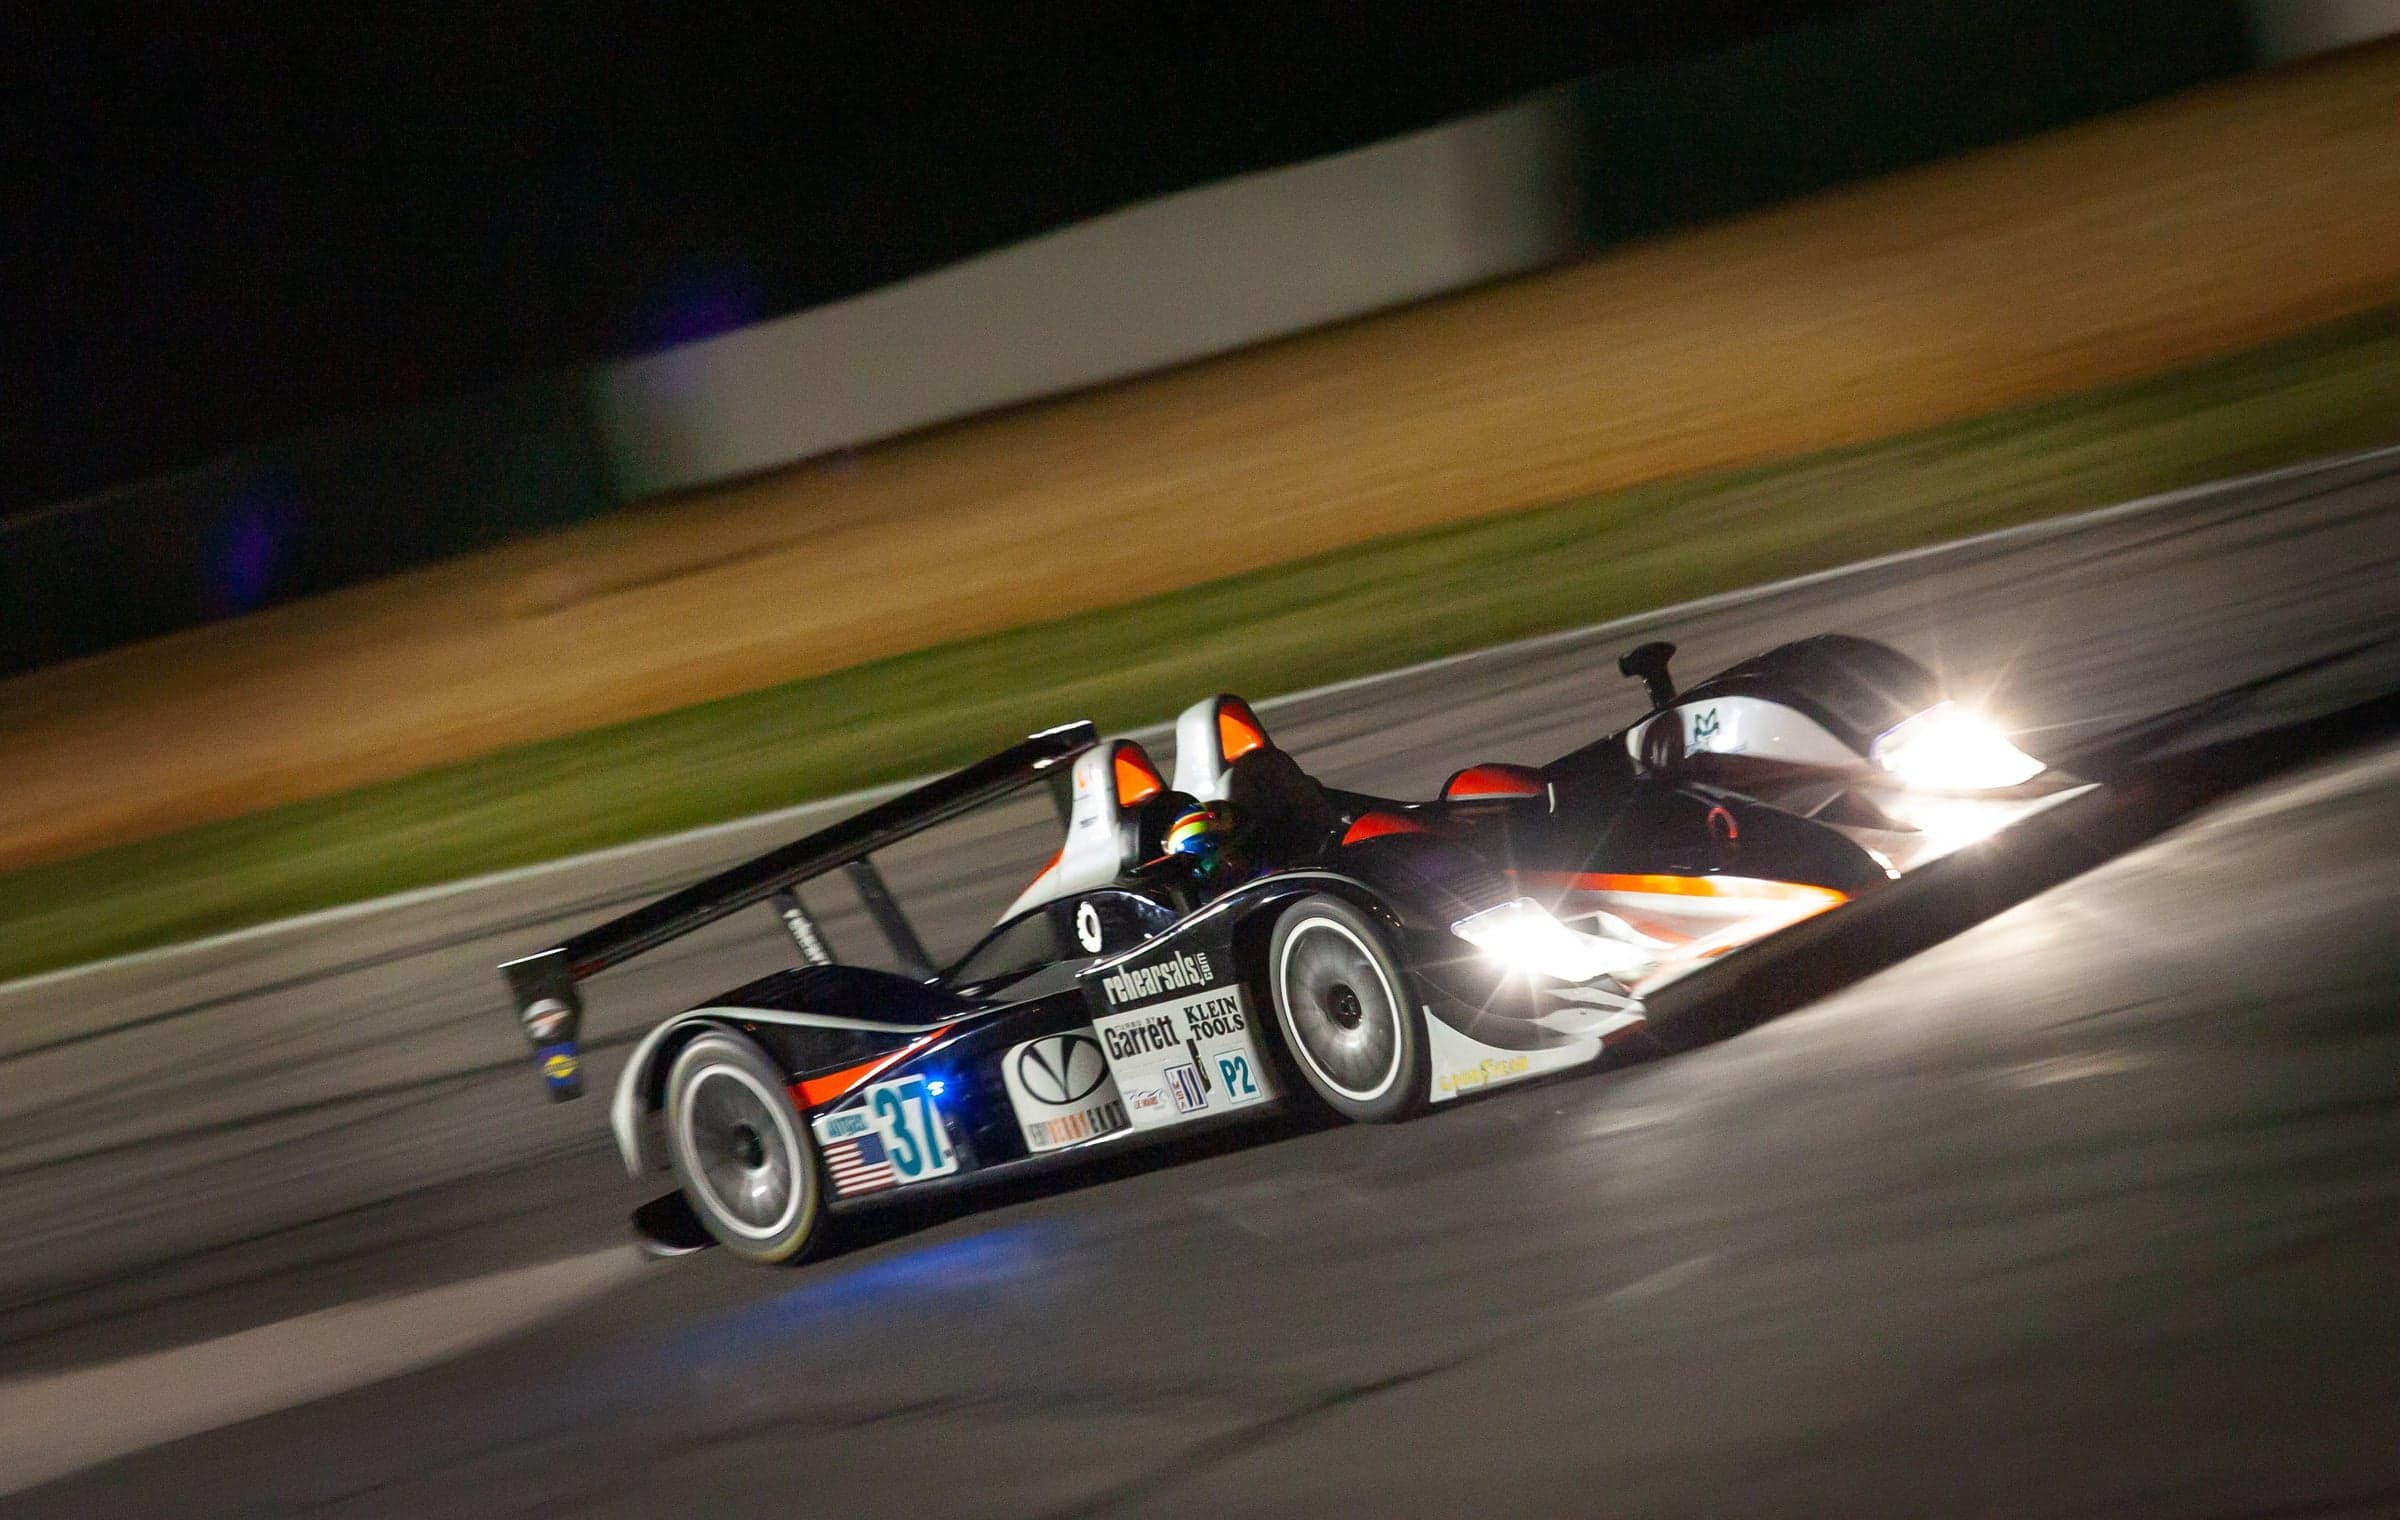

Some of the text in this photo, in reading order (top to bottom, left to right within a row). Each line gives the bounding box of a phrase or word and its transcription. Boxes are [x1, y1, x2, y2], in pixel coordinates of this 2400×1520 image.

[1183, 995, 1238, 1025] KLEIN
[1190, 1014, 1245, 1041] TOOLS
[1104, 1015, 1180, 1060] Garrett
[1219, 1056, 1257, 1097] P2
[875, 1081, 944, 1176] 37
